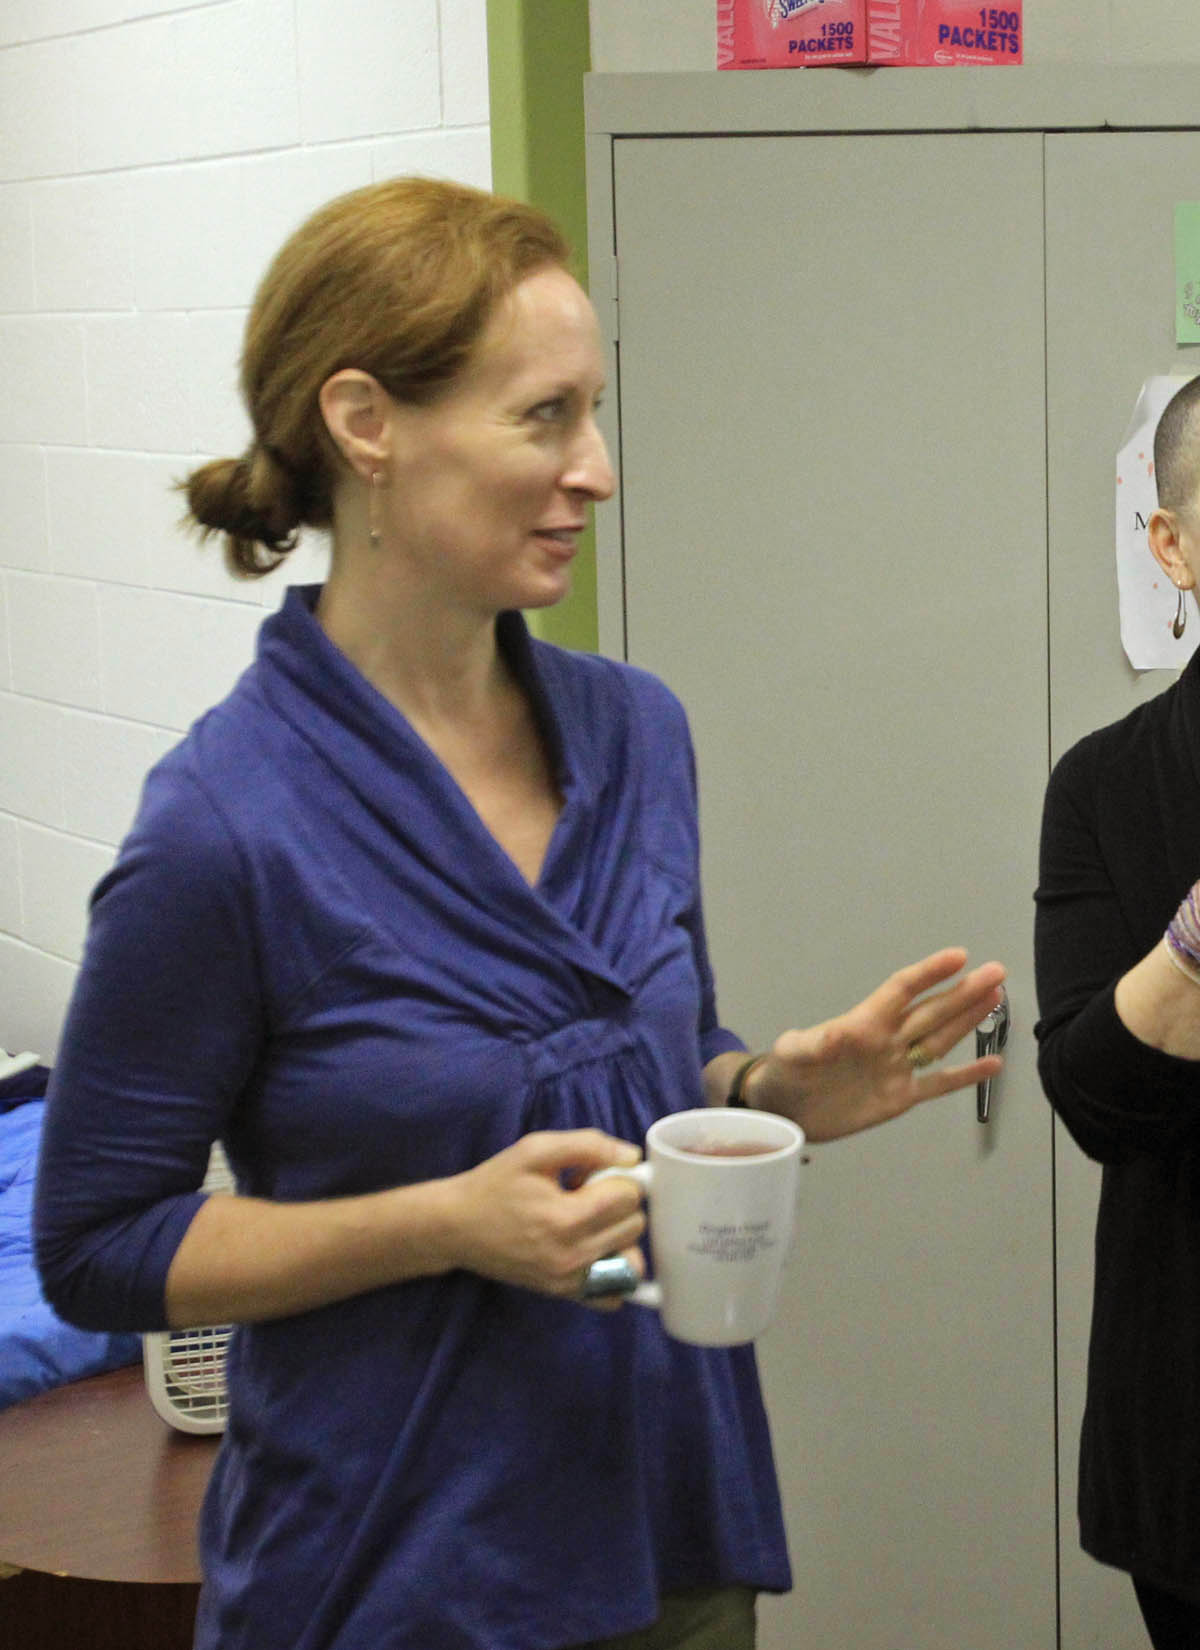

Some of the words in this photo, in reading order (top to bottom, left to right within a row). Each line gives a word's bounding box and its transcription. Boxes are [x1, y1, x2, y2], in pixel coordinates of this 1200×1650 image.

[821, 21, 854, 36] 1500
[980, 8, 1019, 32] 1500
[788, 36, 854, 53] PACKETS
[938, 24, 1019, 54] PACKETS
